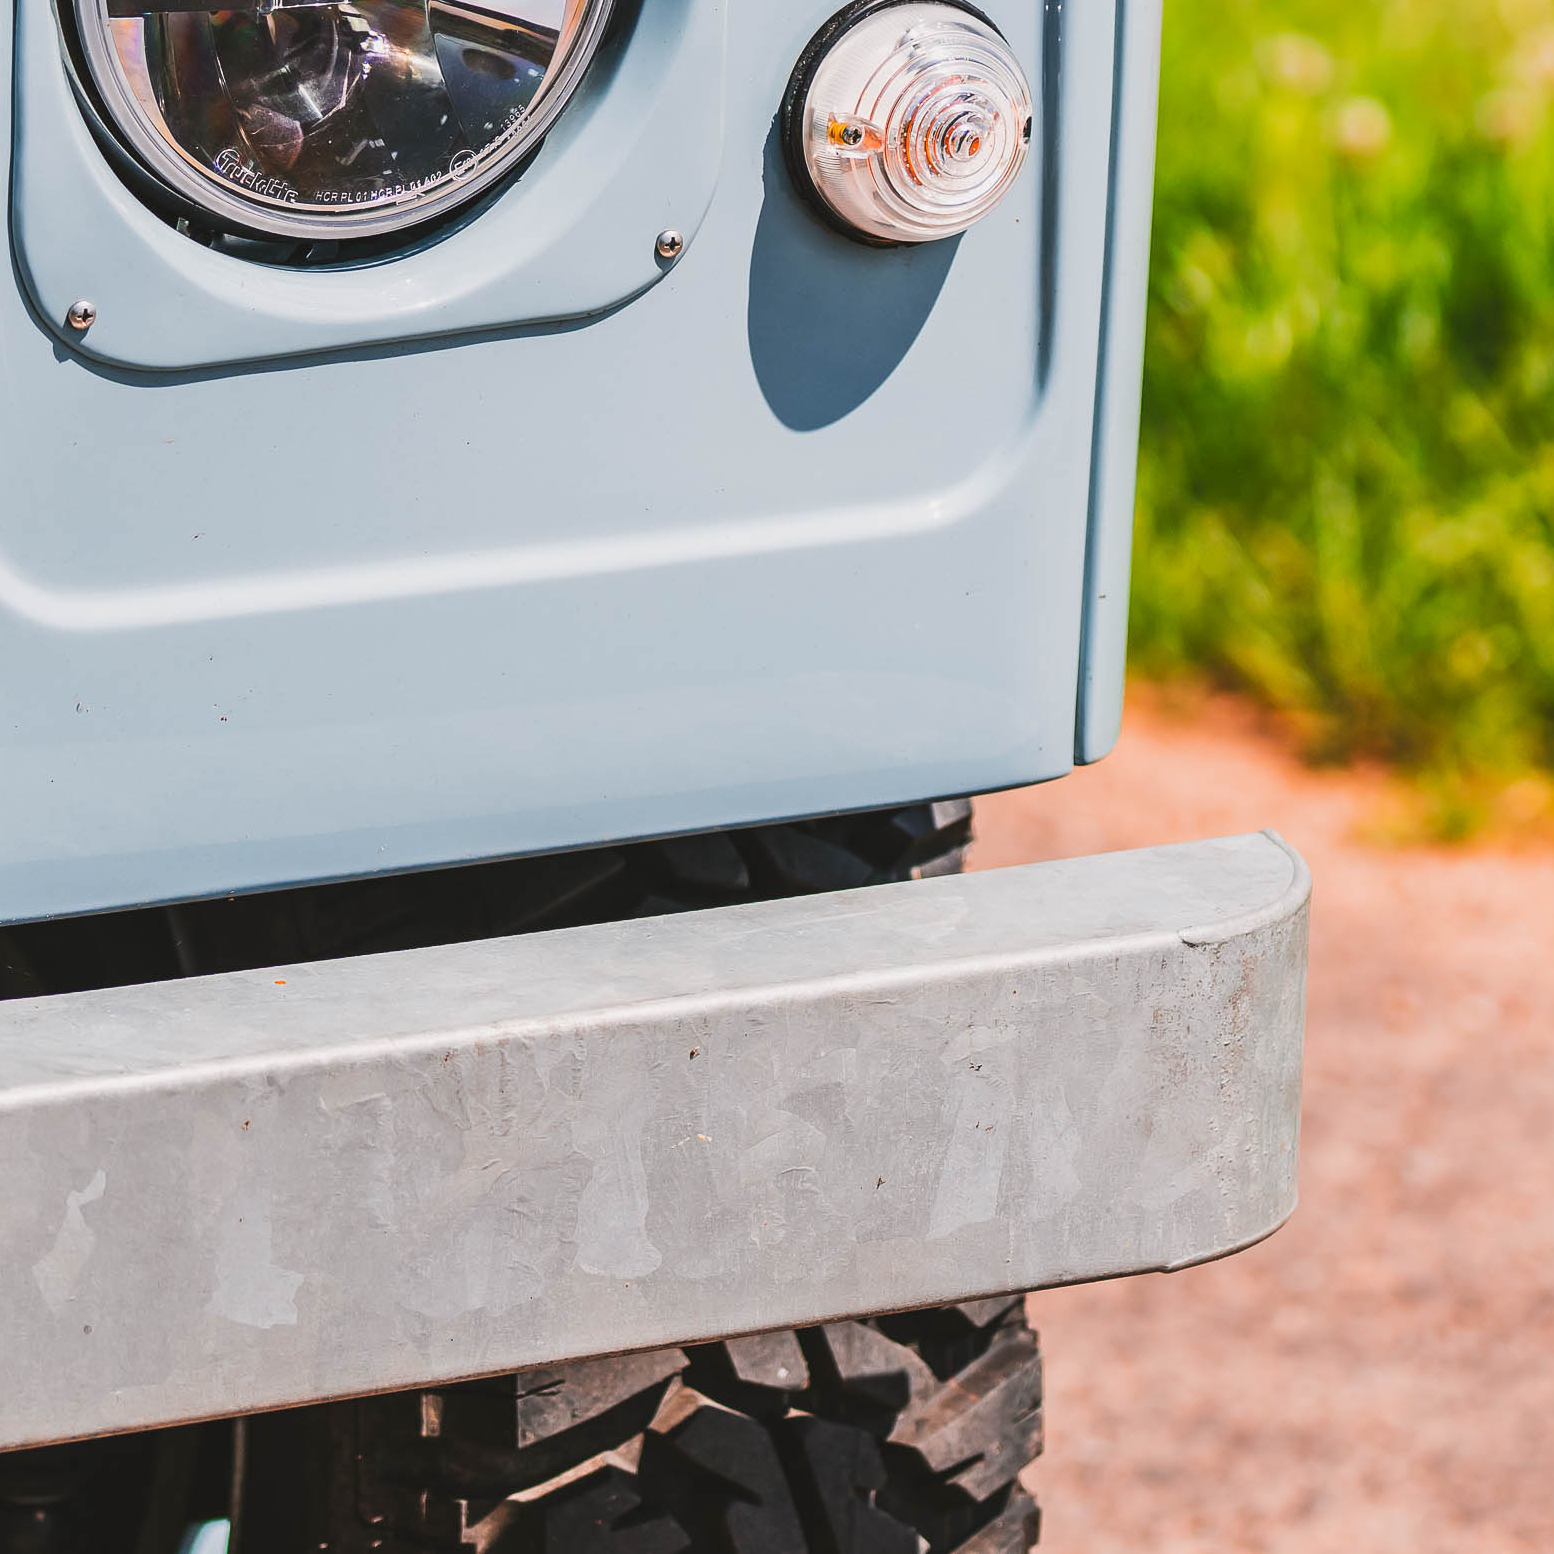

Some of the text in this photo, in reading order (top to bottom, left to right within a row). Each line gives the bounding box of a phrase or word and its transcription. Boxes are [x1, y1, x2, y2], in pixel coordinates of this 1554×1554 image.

[316, 191, 338, 202] HCR
[341, 192, 354, 202] PL
[356, 191, 367, 202] 01
[371, 187, 393, 200] HCR
